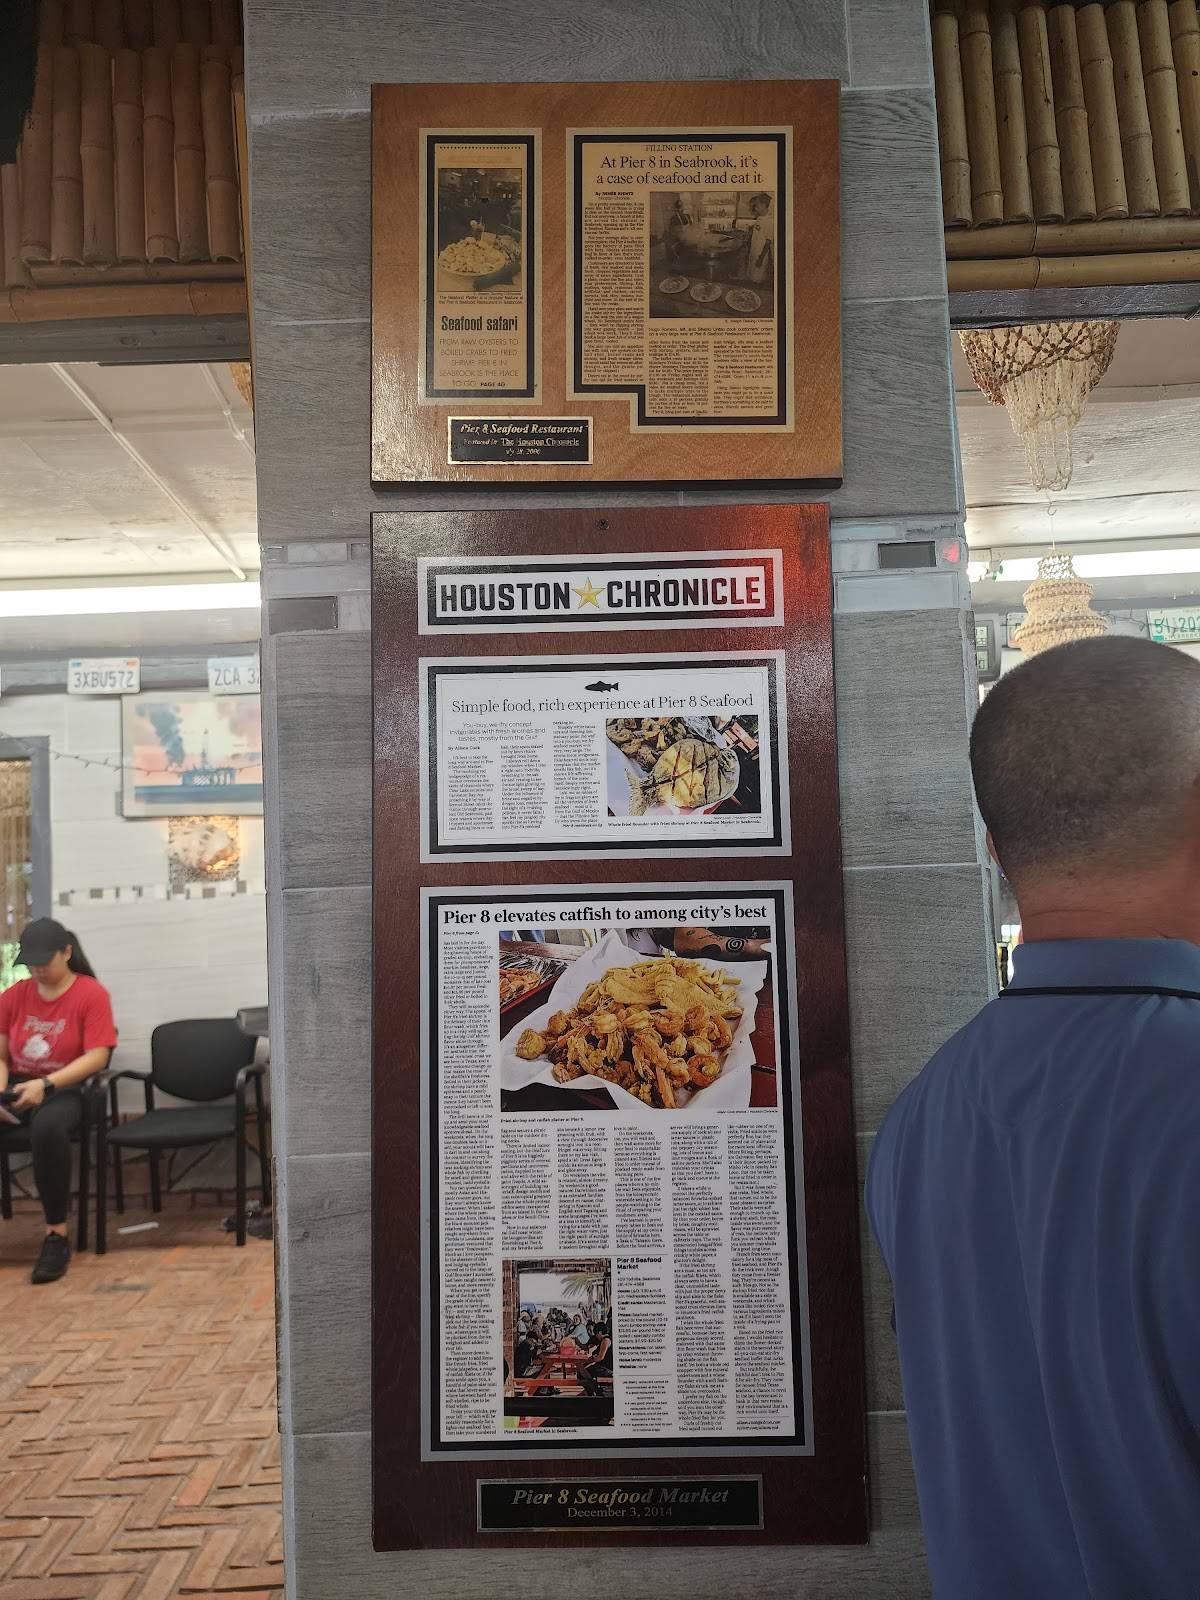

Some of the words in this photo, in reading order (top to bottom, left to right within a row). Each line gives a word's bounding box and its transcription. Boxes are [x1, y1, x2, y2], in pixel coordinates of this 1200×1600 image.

[600, 156, 616, 168] At
[620, 156, 646, 168] Pier
[648, 156, 656, 168] 8
[660, 156, 671, 168] in
[674, 156, 737, 170] Seabrook,
[740, 155, 758, 168] it's
[607, 174, 634, 184] case
[636, 172, 651, 184] of
[652, 172, 701, 184] seafood
[704, 172, 728, 184] and
[730, 173, 750, 184] eat
[752, 172, 762, 184] it
[441, 316, 482, 331] Seafood
[486, 316, 518, 331] safari
[460, 424, 480, 434] Pier
[490, 424, 529, 435] Seafood
[531, 424, 583, 433] Restaurant
[440, 582, 571, 612] HOUSTON
[606, 576, 761, 608] CHRONICLE
[74, 671, 135, 688] 3XBU572
[214, 668, 241, 686] ZCA
[248, 668, 260, 684] 3
[452, 700, 500, 716] Simple
[502, 699, 536, 713] food,
[538, 698, 565, 712] rich
[566, 698, 642, 713] experience
[643, 698, 655, 709] at
[658, 696, 686, 708] Pier
[689, 696, 697, 708] 8
[700, 693, 753, 708] Seafood
[444, 910, 477, 924] Pier
[480, 910, 491, 923] 8
[494, 909, 556, 923] elevates
[559, 906, 611, 921] catfish
[616, 907, 631, 920] to
[634, 908, 688, 922] among
[690, 905, 731, 922] city's
[734, 904, 767, 918] best
[512, 1488, 552, 1505] Pier
[558, 1488, 569, 1504] 8
[574, 1488, 654, 1507] Seafood
[659, 1487, 729, 1504] Market
[567, 1507, 626, 1518] December
[630, 1507, 641, 1518] 3,
[644, 1506, 672, 1518] 2014
